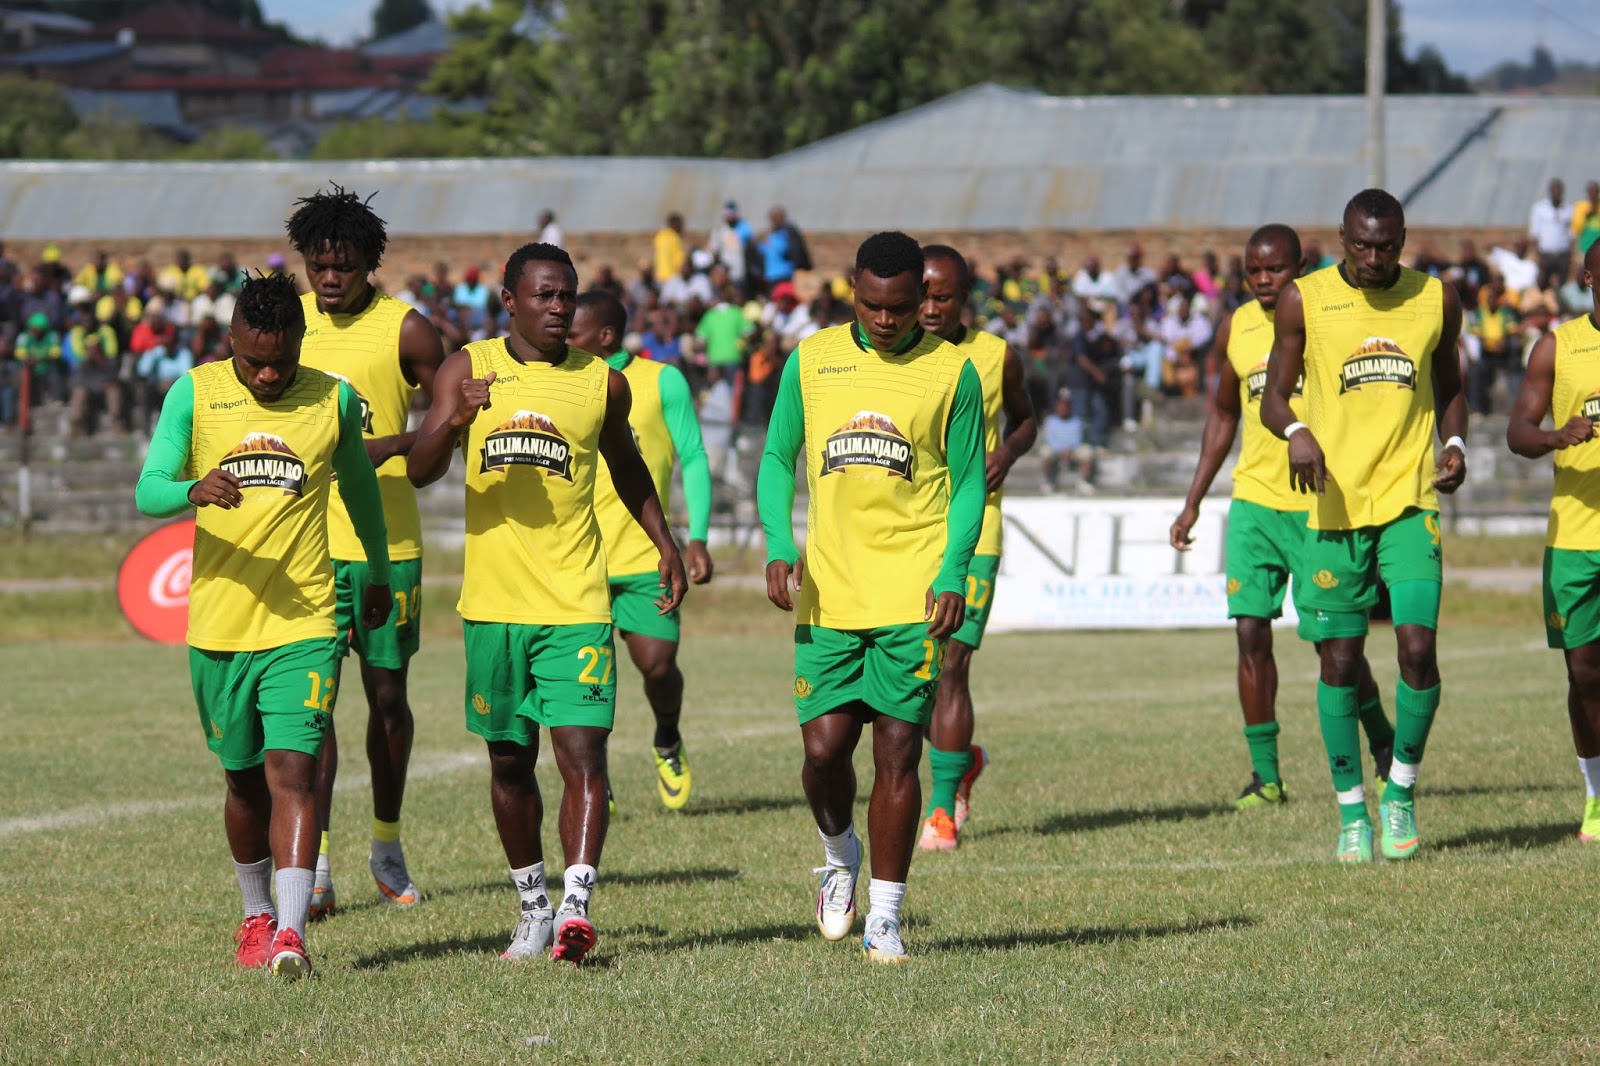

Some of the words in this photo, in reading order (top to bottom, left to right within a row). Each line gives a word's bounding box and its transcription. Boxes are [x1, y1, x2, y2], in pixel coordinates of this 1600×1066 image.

[818, 364, 857, 374] uhlsport
[1344, 358, 1413, 380] KILIMANJARO
[210, 398, 248, 410] uhlsport
[486, 437, 567, 462] KILIMANJARO
[828, 437, 909, 463] KILIMANJARO
[873, 458, 890, 466] LAGER
[1424, 514, 1440, 545] 9
[966, 576, 990, 608] 17
[394, 585, 421, 626] 10
[578, 646, 612, 684] 27
[304, 672, 334, 712] 12
[582, 694, 608, 703] KELME
